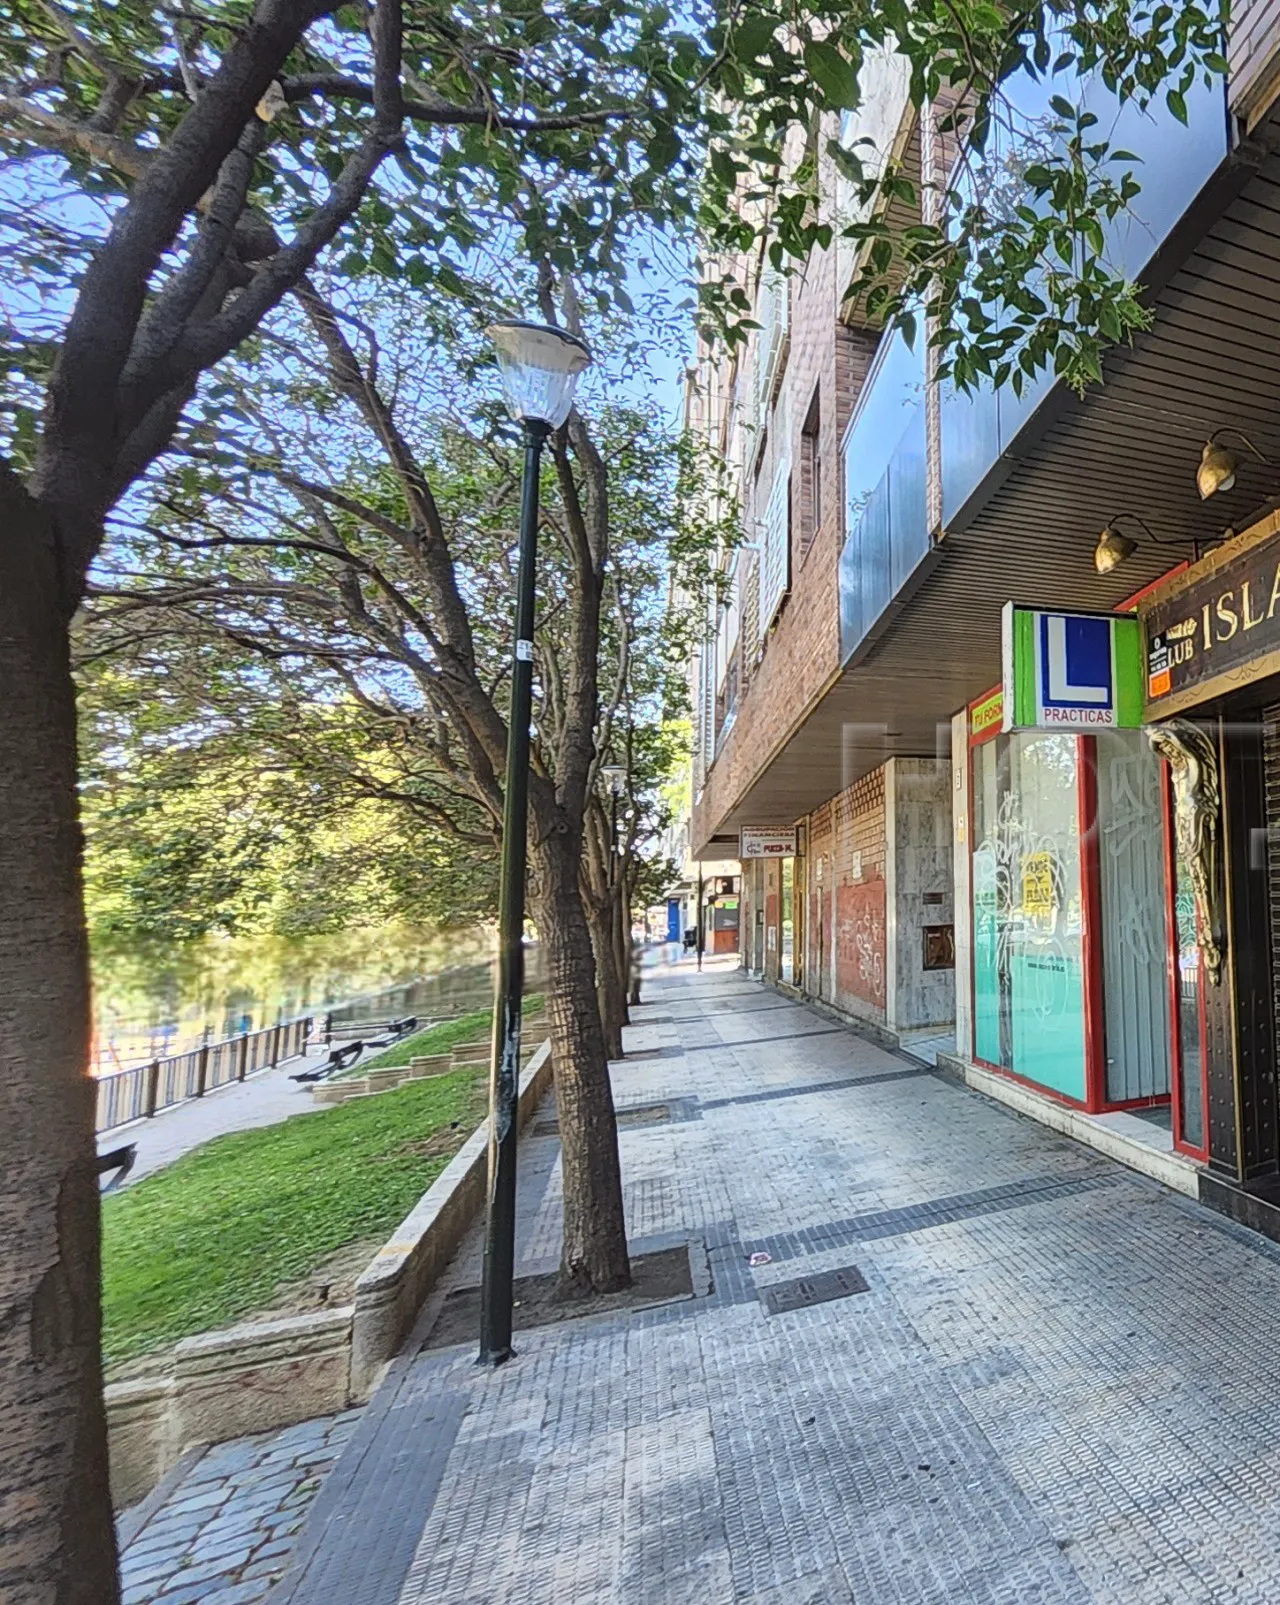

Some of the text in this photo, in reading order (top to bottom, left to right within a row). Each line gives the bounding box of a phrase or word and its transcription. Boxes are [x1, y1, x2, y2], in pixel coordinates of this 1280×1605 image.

[1047, 616, 1109, 704] L
[1167, 637, 1194, 668] LUB
[1044, 707, 1113, 724] PRACTICAS
